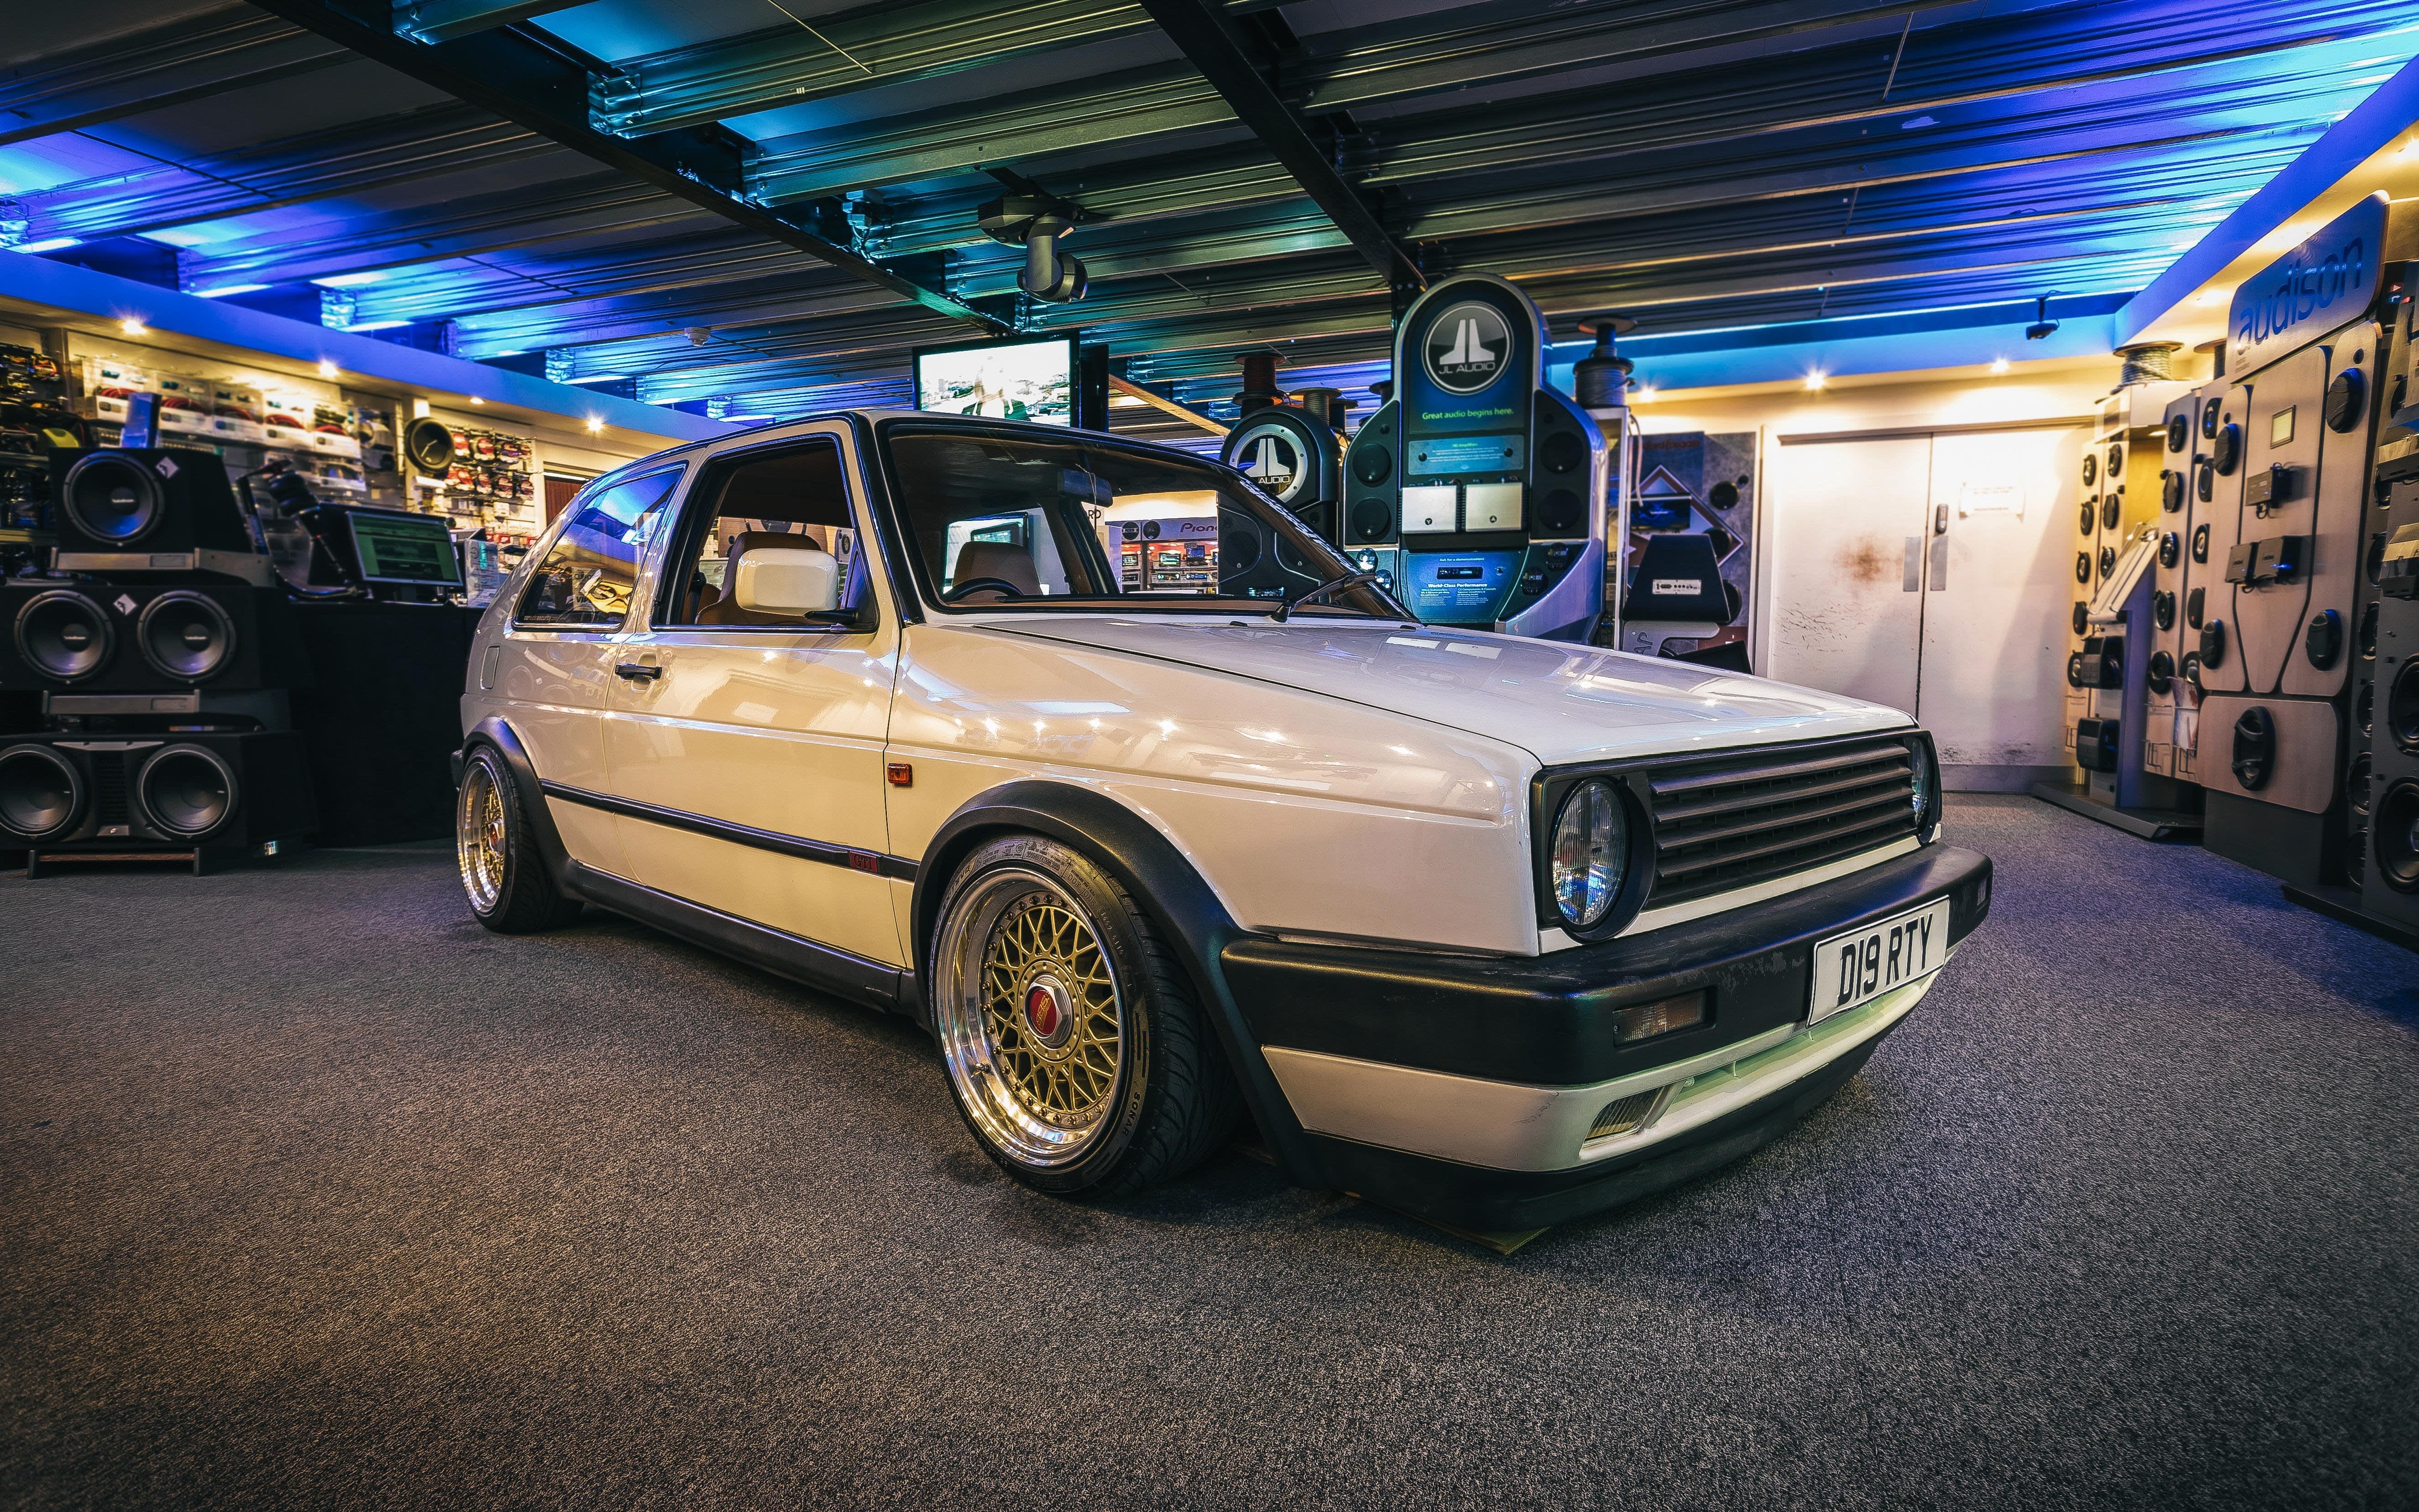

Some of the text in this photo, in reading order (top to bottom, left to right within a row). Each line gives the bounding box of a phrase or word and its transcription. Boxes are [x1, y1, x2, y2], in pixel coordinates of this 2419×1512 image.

[2238, 237, 2363, 355] audison
[1439, 362, 1495, 374] JL AUDIO
[1467, 409, 1492, 418] begins
[1067, 874, 1081, 888] DOT
[1837, 913, 1933, 1006] D19 RTY
[1122, 1092, 1141, 1136] SONAR
